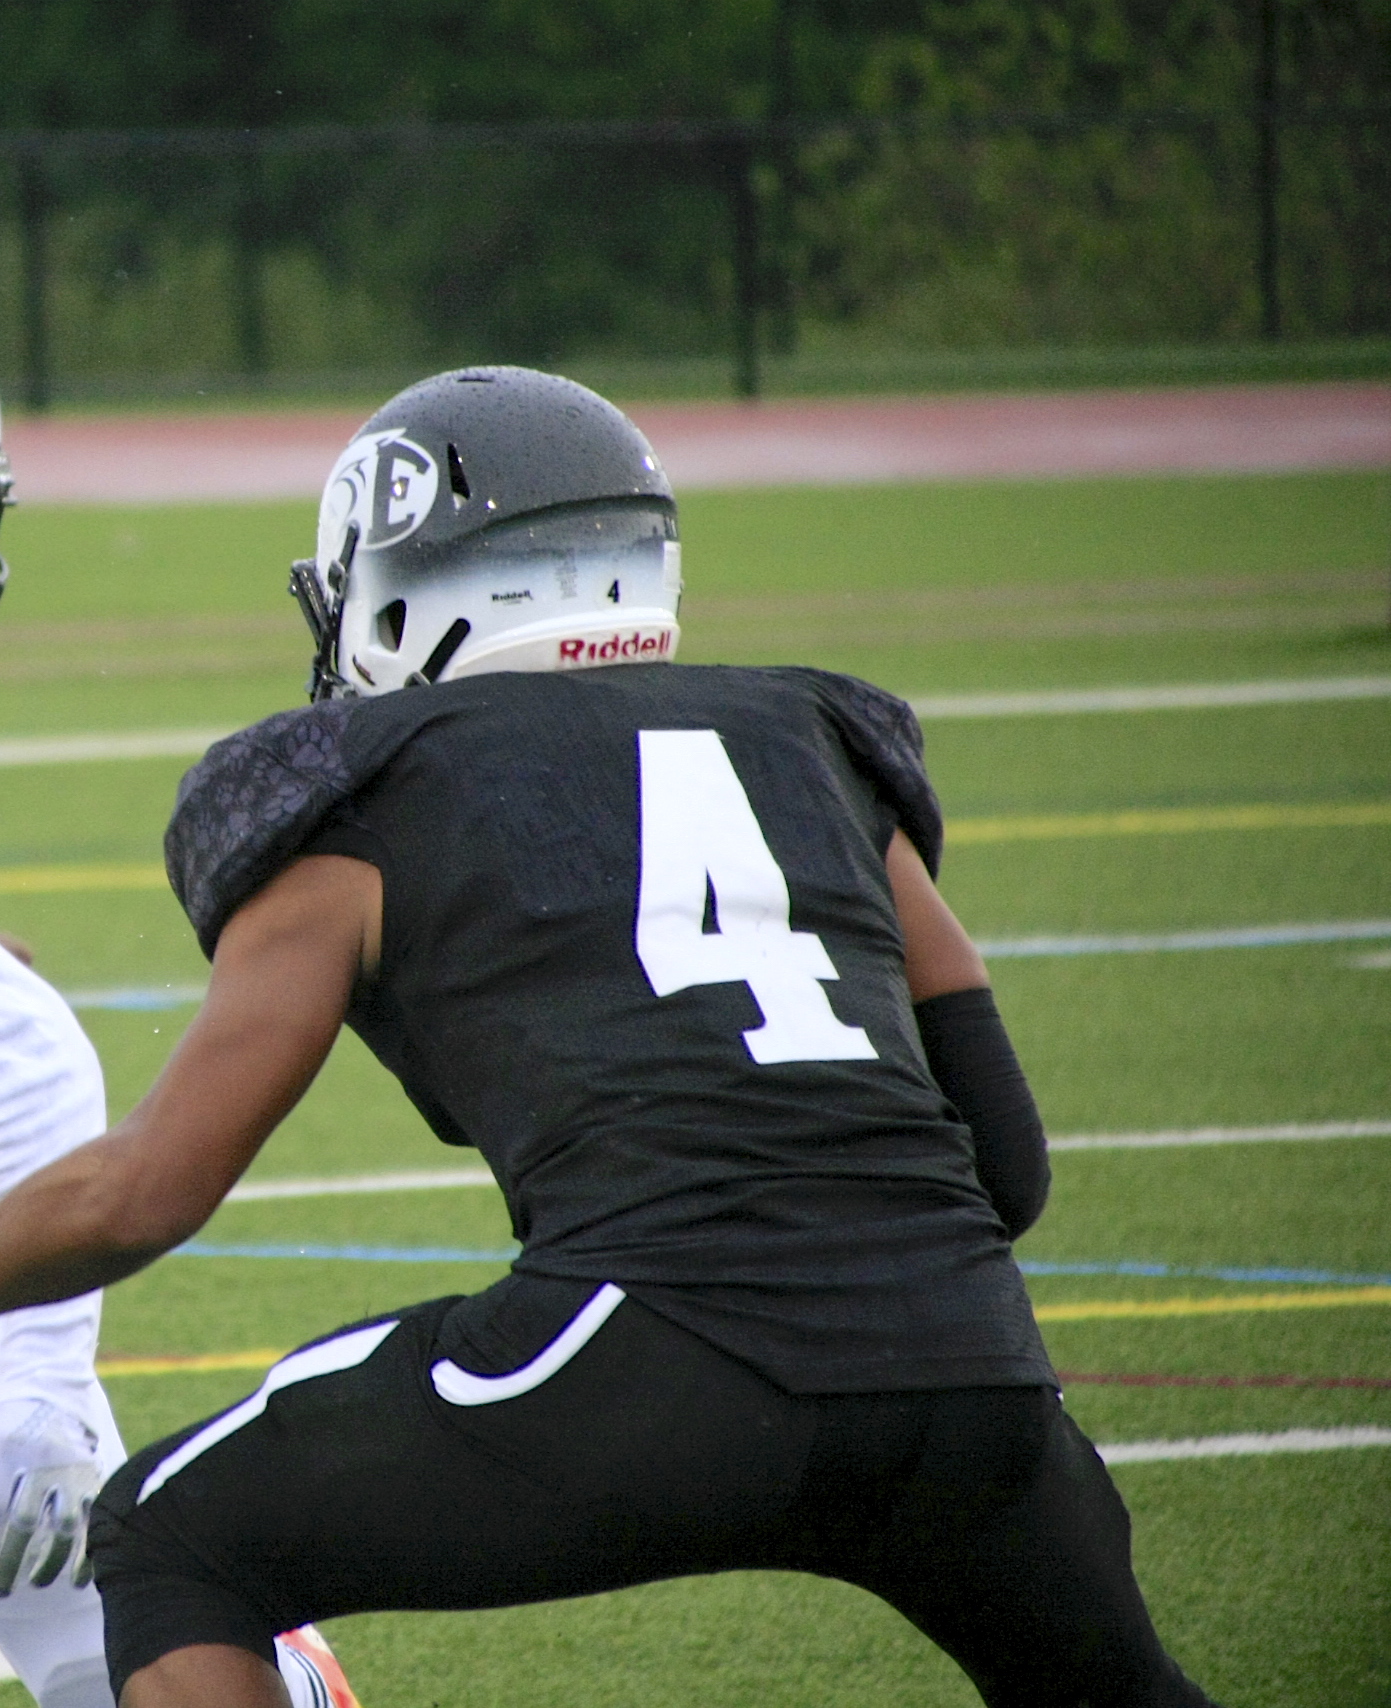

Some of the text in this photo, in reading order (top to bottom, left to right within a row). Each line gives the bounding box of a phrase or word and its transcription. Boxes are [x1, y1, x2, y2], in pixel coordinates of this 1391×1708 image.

[491, 590, 530, 602] Riddell
[607, 579, 620, 603] 4
[559, 631, 671, 662] Riddell
[634, 728, 880, 1066] 4
